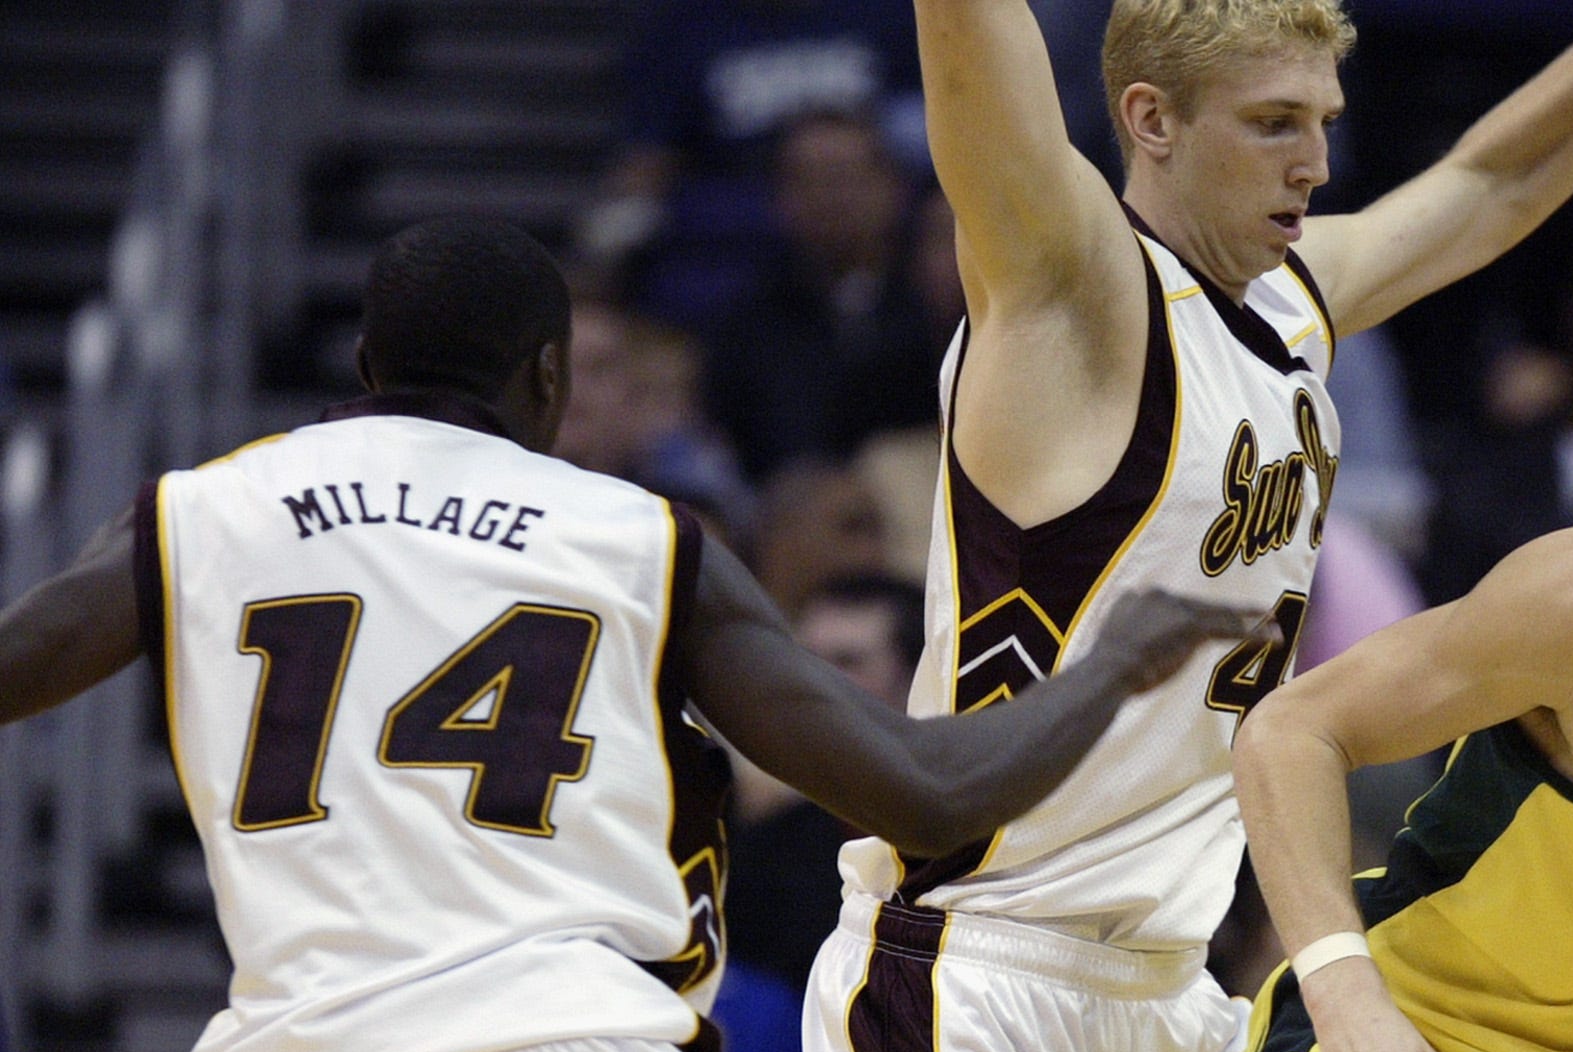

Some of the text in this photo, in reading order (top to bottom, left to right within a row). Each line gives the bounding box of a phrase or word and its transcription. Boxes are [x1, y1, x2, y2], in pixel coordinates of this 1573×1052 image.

[280, 480, 546, 552] MILLAGE
[1201, 418, 1304, 577] Sun
[231, 591, 602, 839] 14
